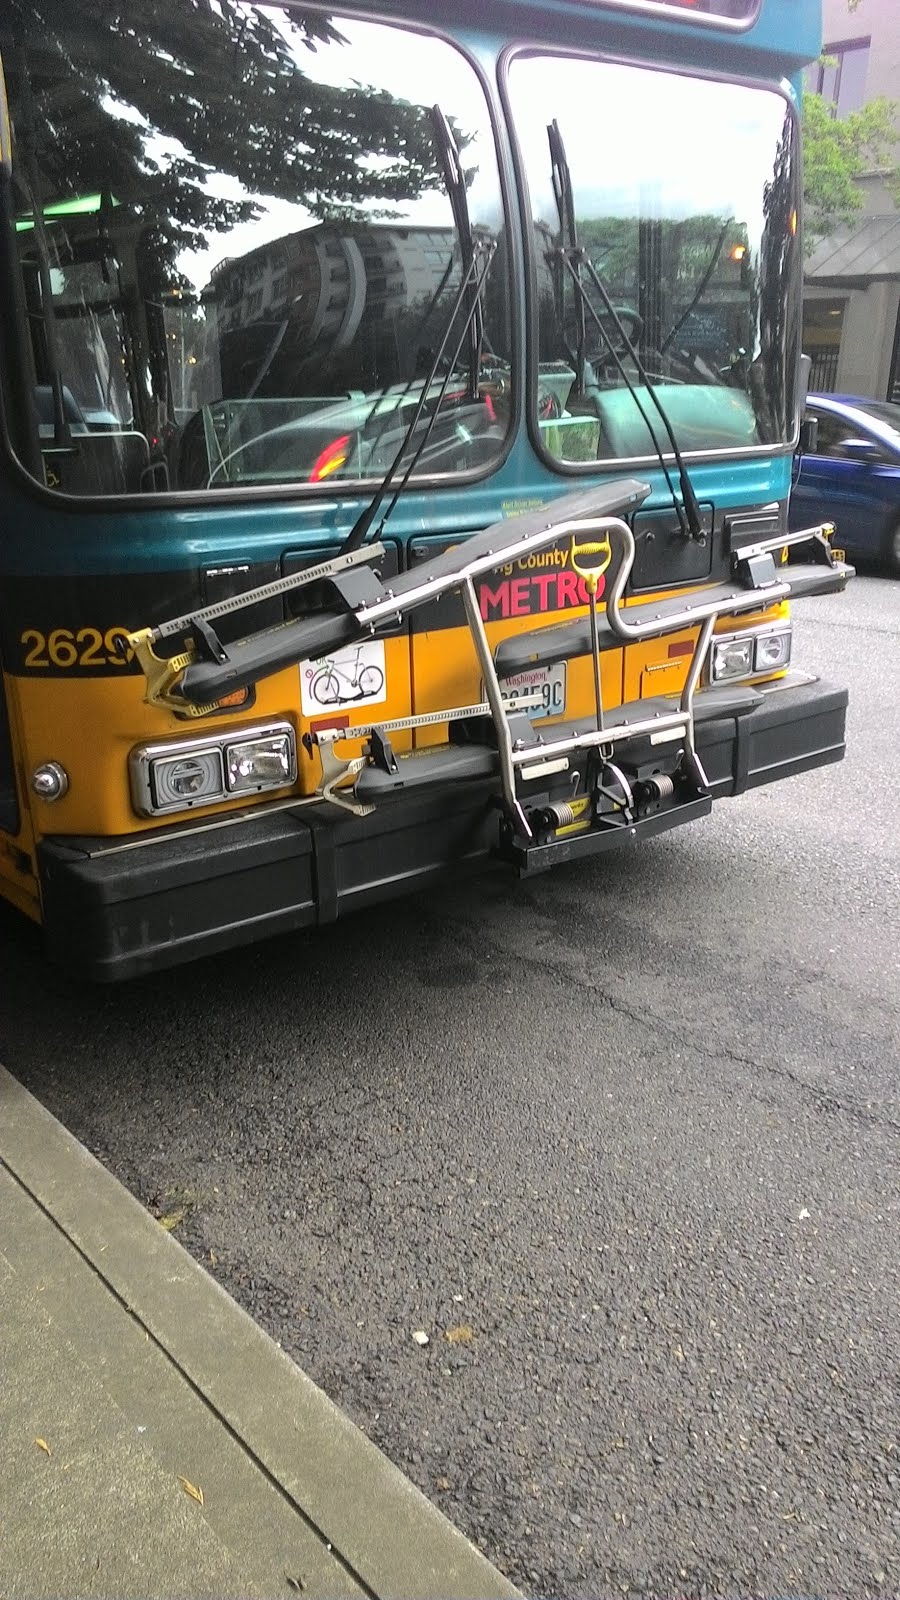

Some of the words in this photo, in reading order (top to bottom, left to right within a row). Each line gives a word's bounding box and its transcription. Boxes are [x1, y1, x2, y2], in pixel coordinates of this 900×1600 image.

[518, 548, 569, 570] County
[480, 570, 606, 620] METRO
[21, 627, 135, 667] 2629
[505, 671, 547, 687] Washington
